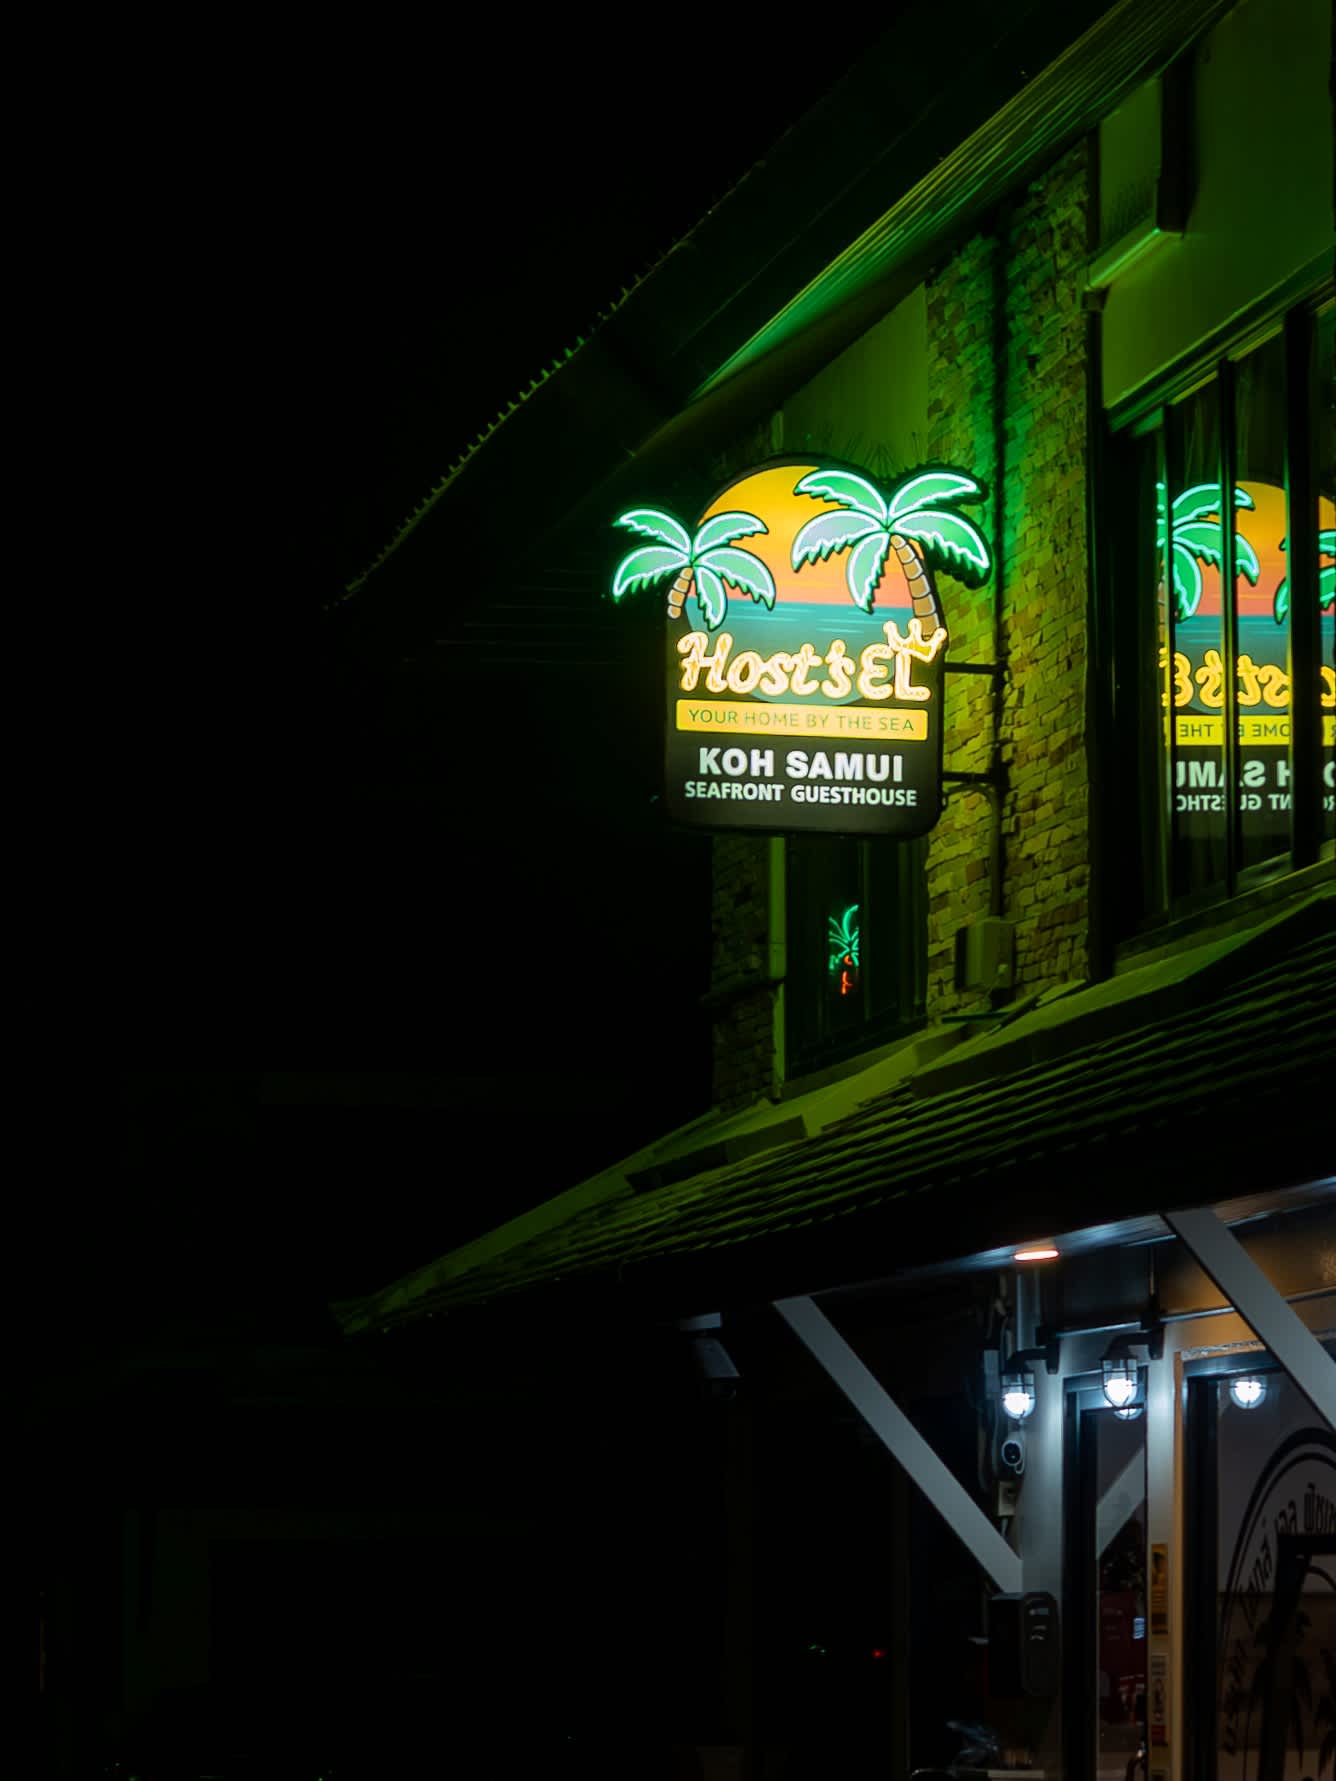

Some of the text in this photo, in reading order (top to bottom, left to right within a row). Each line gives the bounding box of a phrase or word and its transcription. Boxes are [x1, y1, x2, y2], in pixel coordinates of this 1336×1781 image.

[688, 708, 915, 732] YOUR HOME BY THE SEA
[699, 747, 903, 782] KOH SAMUI
[684, 780, 918, 806] SEAFRONT GUESTHOUSE
